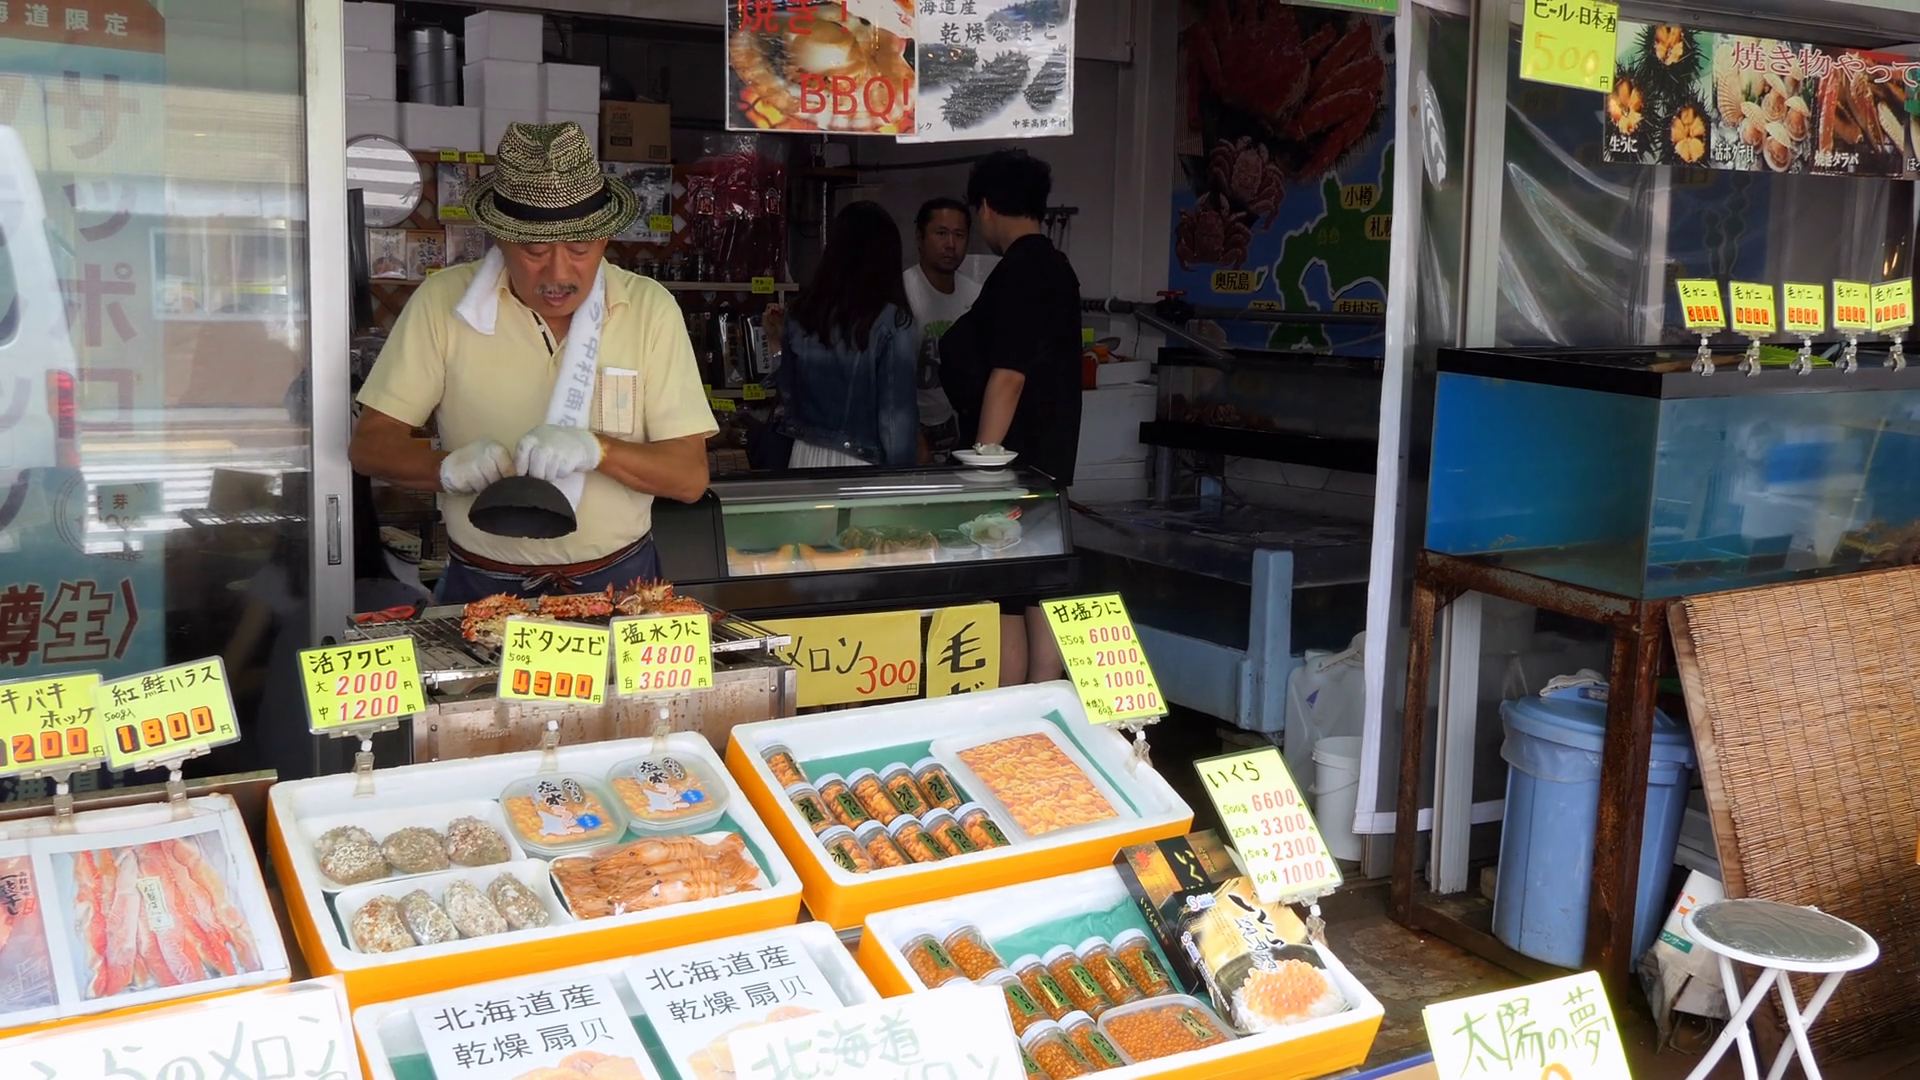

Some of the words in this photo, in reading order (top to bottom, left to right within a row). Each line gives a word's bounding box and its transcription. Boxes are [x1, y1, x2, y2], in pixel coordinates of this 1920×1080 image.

[940, 22, 1058, 45] 乾燥なまこ
[1532, 32, 1600, 76] 500
[1600, 76, 1609, 89] 円
[800, 73, 911, 123] BBQ!
[1609, 135, 1638, 154] 生うに
[1345, 193, 1373, 208] 小樽
[1215, 272, 1250, 291] 奥尻島
[1052, 601, 1122, 623] 甘塩うに
[511, 627, 605, 656] ボタンエビ
[621, 620, 701, 645] 塩水うに
[1089, 625, 1131, 644] 6000
[309, 645, 395, 675] 活アワビ
[508, 653, 532, 665] 500g
[622, 651, 633, 664] 赤
[640, 644, 695, 666] 4800
[698, 656, 707, 666] 円
[786, 636, 863, 674] メロン
[856, 655, 917, 695] 300
[1096, 648, 1138, 667] 2000
[111, 665, 221, 707] 紅鮭ハラス
[315, 681, 328, 694] 大
[336, 670, 398, 696] 2000
[403, 680, 413, 689] 円
[512, 668, 593, 699] 4500
[593, 694, 601, 703] 円
[625, 678, 633, 689] 白
[640, 668, 692, 690] 3600
[698, 677, 707, 687] 円
[1105, 669, 1145, 688] 1000
[318, 706, 329, 720] 中
[340, 695, 399, 721] 1200
[407, 703, 416, 712] 円
[1115, 692, 1157, 713] 2300
[40, 708, 95, 729] ホッケ
[116, 705, 215, 754] 1800
[220, 723, 233, 734] 円
[0, 727, 89, 767] 200
[93, 745, 105, 757] 円
[1207, 760, 1261, 788] いくら
[1223, 803, 1248, 815] 500g
[1251, 788, 1295, 812] 6600
[1232, 825, 1259, 838] 250g
[1261, 813, 1306, 836] 3300
[1272, 836, 1316, 862] 2300
[1257, 871, 1278, 884] 60g
[1282, 860, 1325, 884] 1000
[645, 944, 796, 991] 北海道産
[434, 983, 601, 1032] 北海道産
[752, 1009, 925, 1080] 北海道
[1452, 986, 1611, 1079] 太陽の夢
